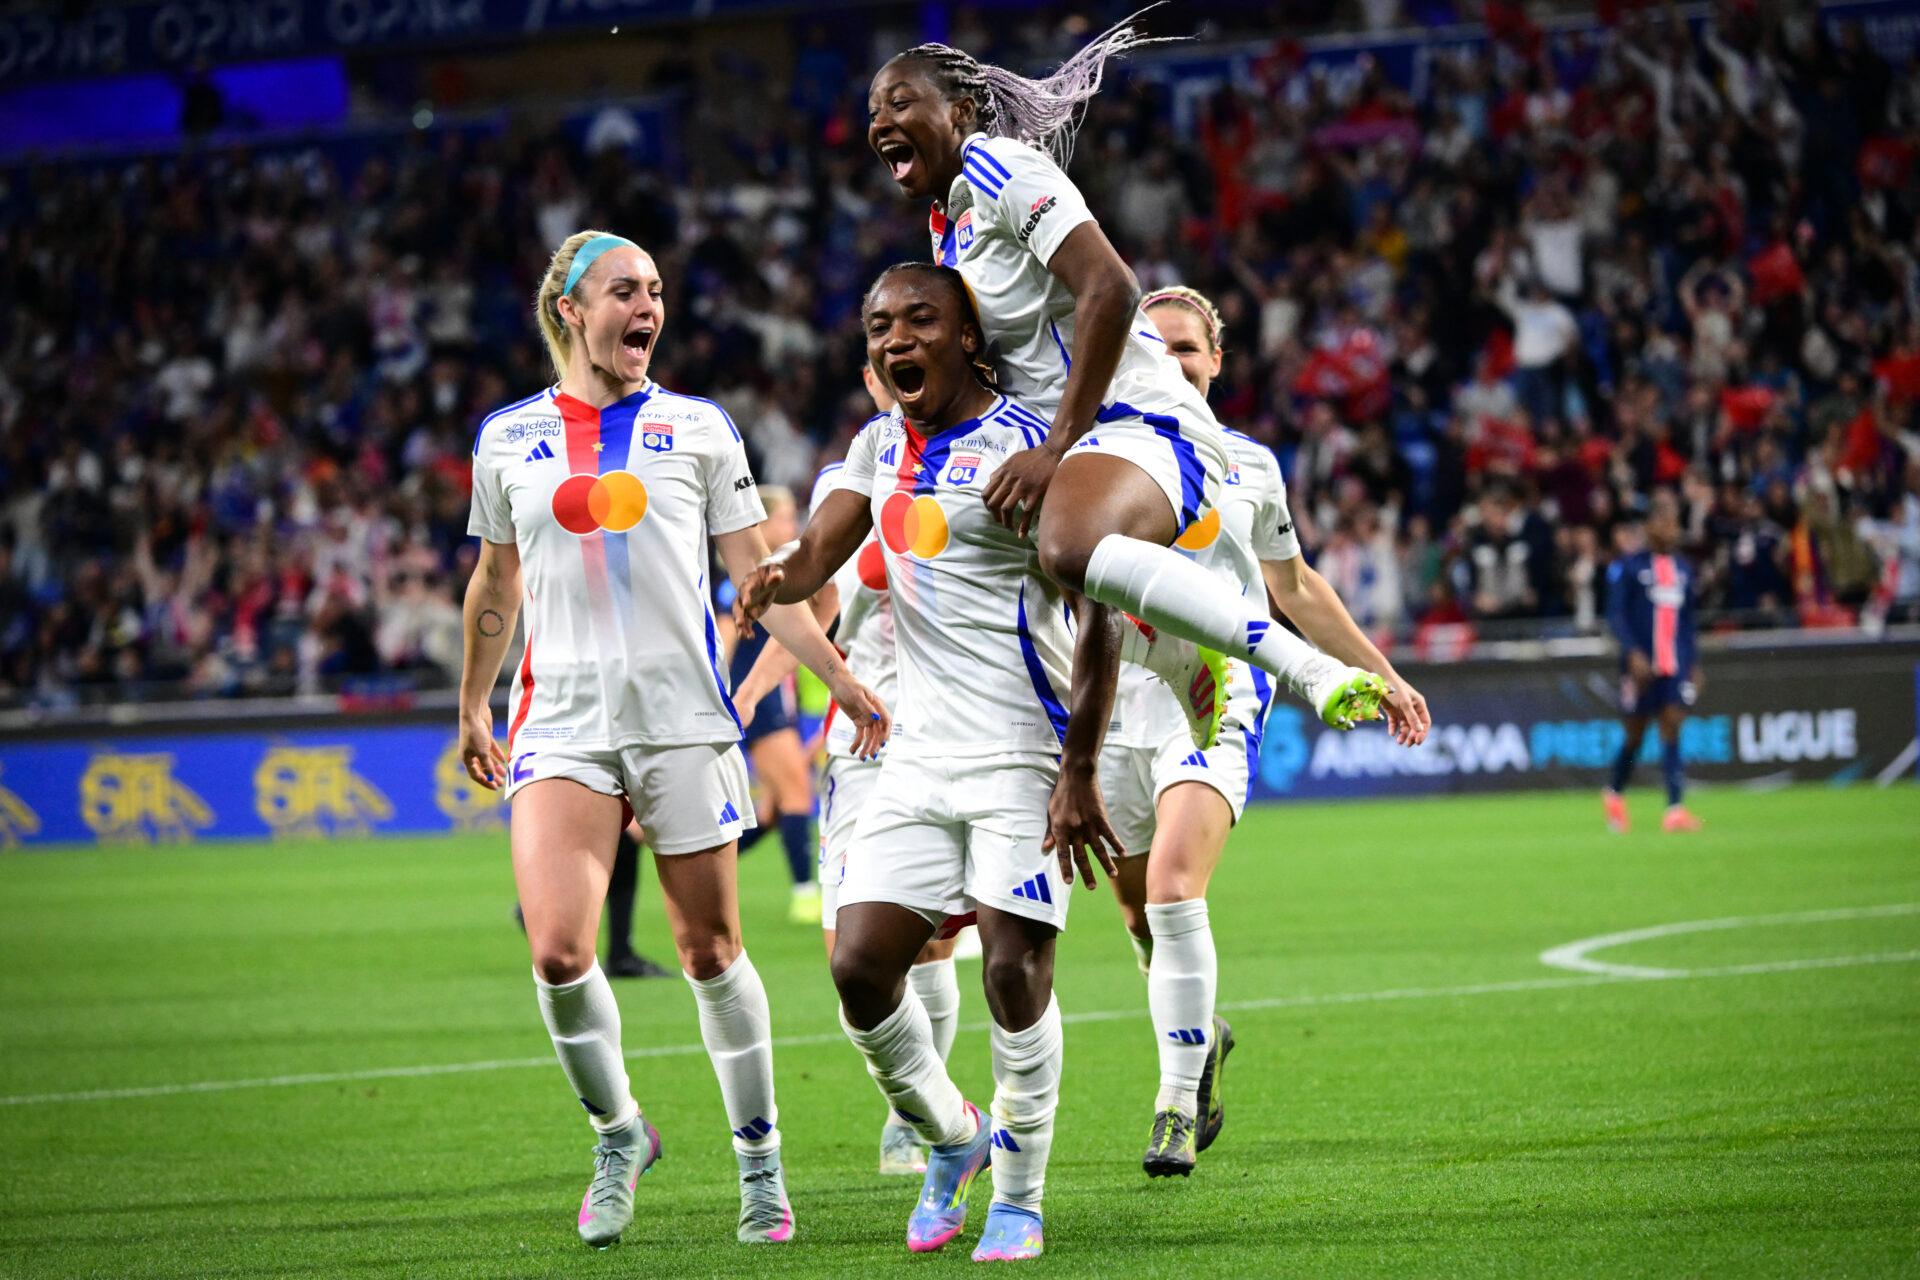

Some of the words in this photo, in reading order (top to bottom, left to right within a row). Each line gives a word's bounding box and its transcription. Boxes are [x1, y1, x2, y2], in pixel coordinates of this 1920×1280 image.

[1018, 196, 1057, 243] Kleber
[525, 416, 561, 430] Idéal
[525, 428, 561, 444] pneu
[644, 434, 670, 449] OL
[950, 467, 972, 481] OL
[1737, 709, 1857, 763] LIGUE
